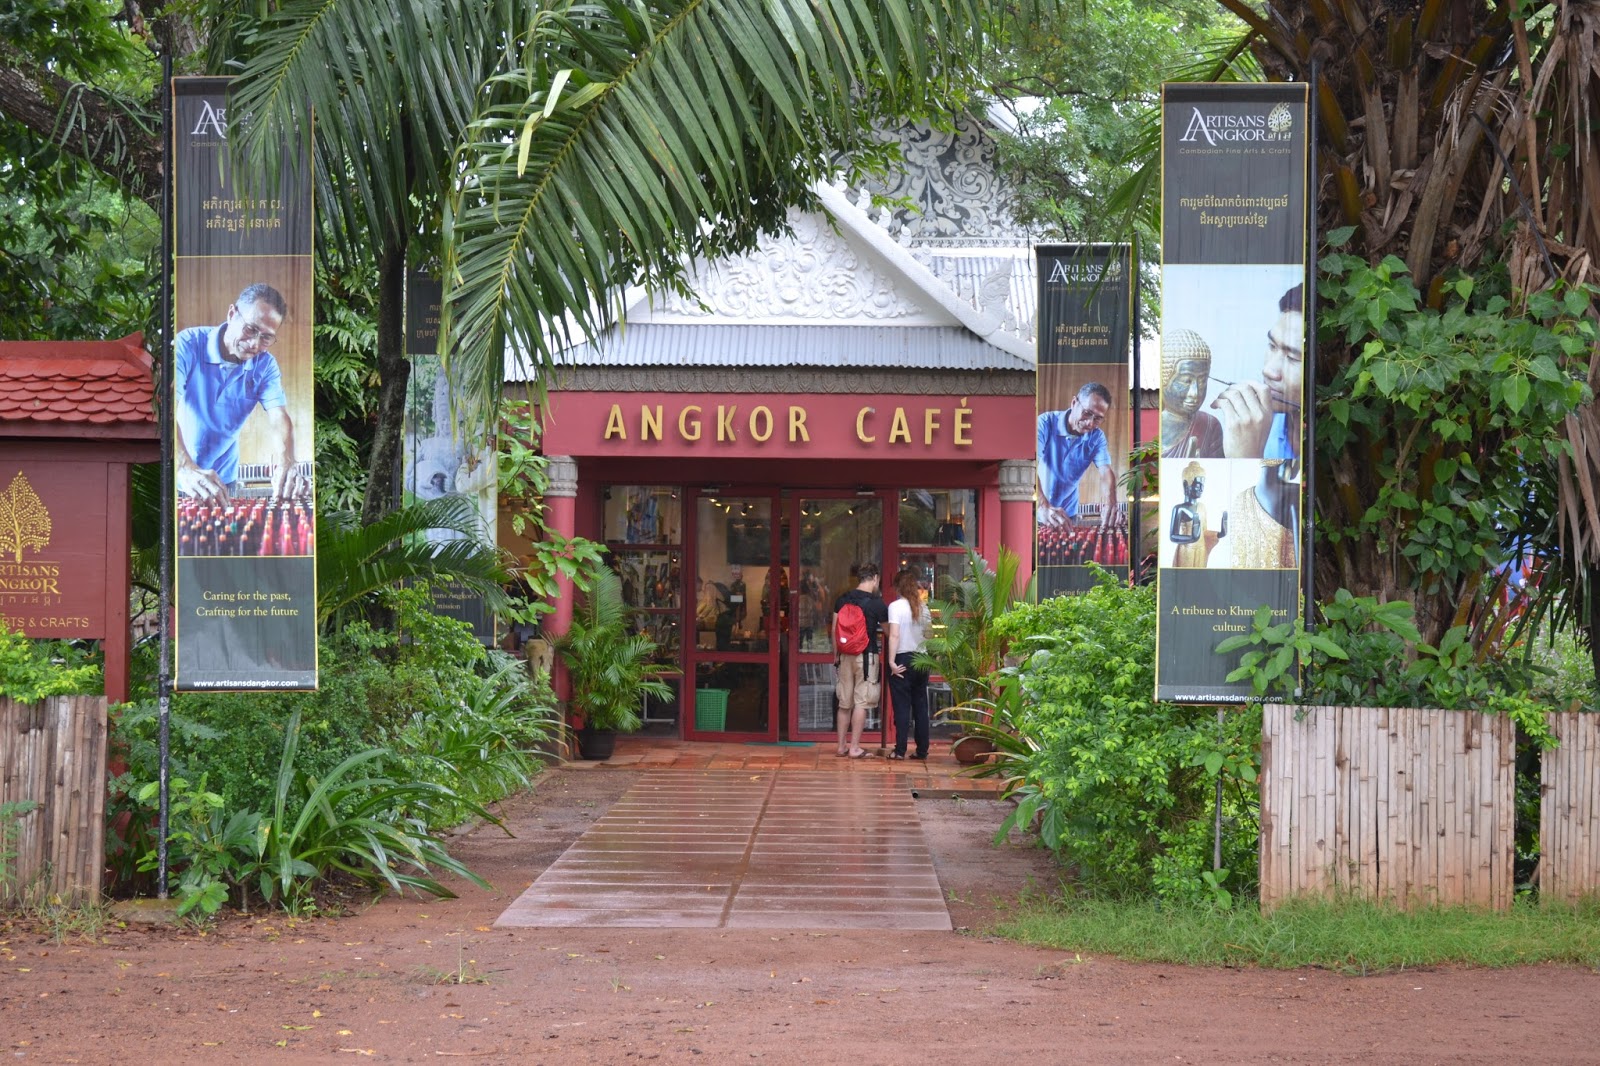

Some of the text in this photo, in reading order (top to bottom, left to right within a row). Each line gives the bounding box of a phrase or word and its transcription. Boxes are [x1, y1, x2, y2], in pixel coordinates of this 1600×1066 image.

[604, 397, 974, 446] ANGKOR CAFÉ
[0, 564, 60, 576] RTISANS
[0, 577, 62, 594] NGKOR
[203, 590, 292, 602] Caring for the past,
[196, 606, 299, 618] Crafting for the future
[1170, 605, 1288, 616] A tribute to Khme reat
[28, 617, 37, 628] &
[40, 617, 89, 628] CRAFTS
[1212, 621, 1247, 632] culture
[193, 680, 299, 688] www.artisansdangkor.com
